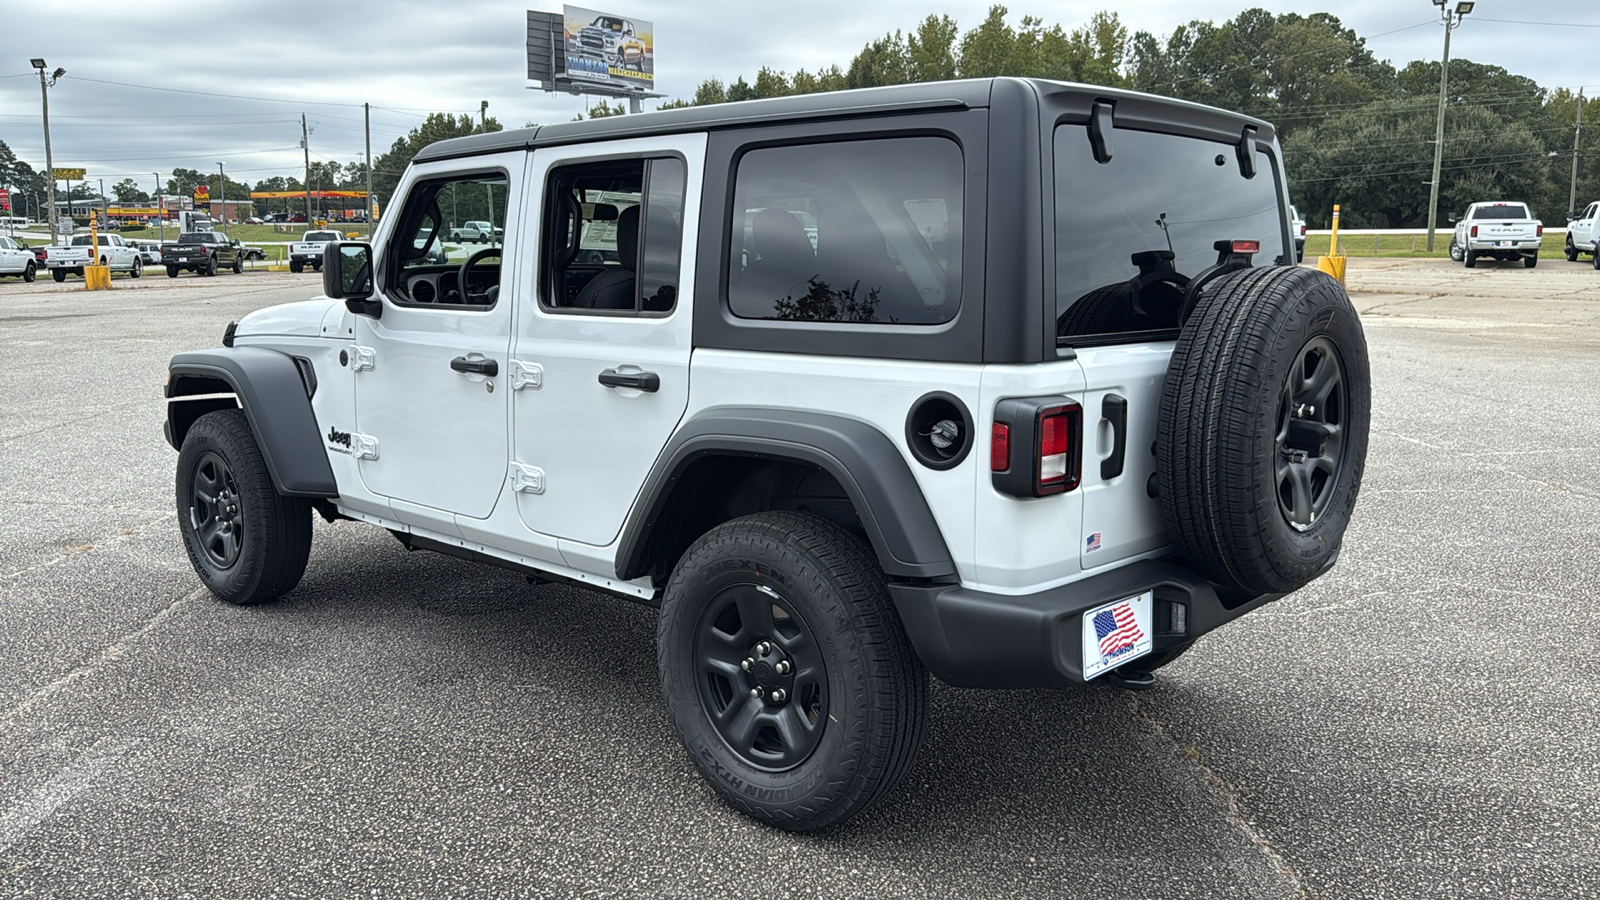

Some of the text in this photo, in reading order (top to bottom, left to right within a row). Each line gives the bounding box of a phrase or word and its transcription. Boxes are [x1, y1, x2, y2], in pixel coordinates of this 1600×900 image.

[567, 56, 609, 75] THOMSON
[328, 426, 351, 449] Jeep
[706, 558, 786, 585] NEXEN
[1109, 643, 1135, 660] THOMSON
[700, 748, 743, 789] HTX2
